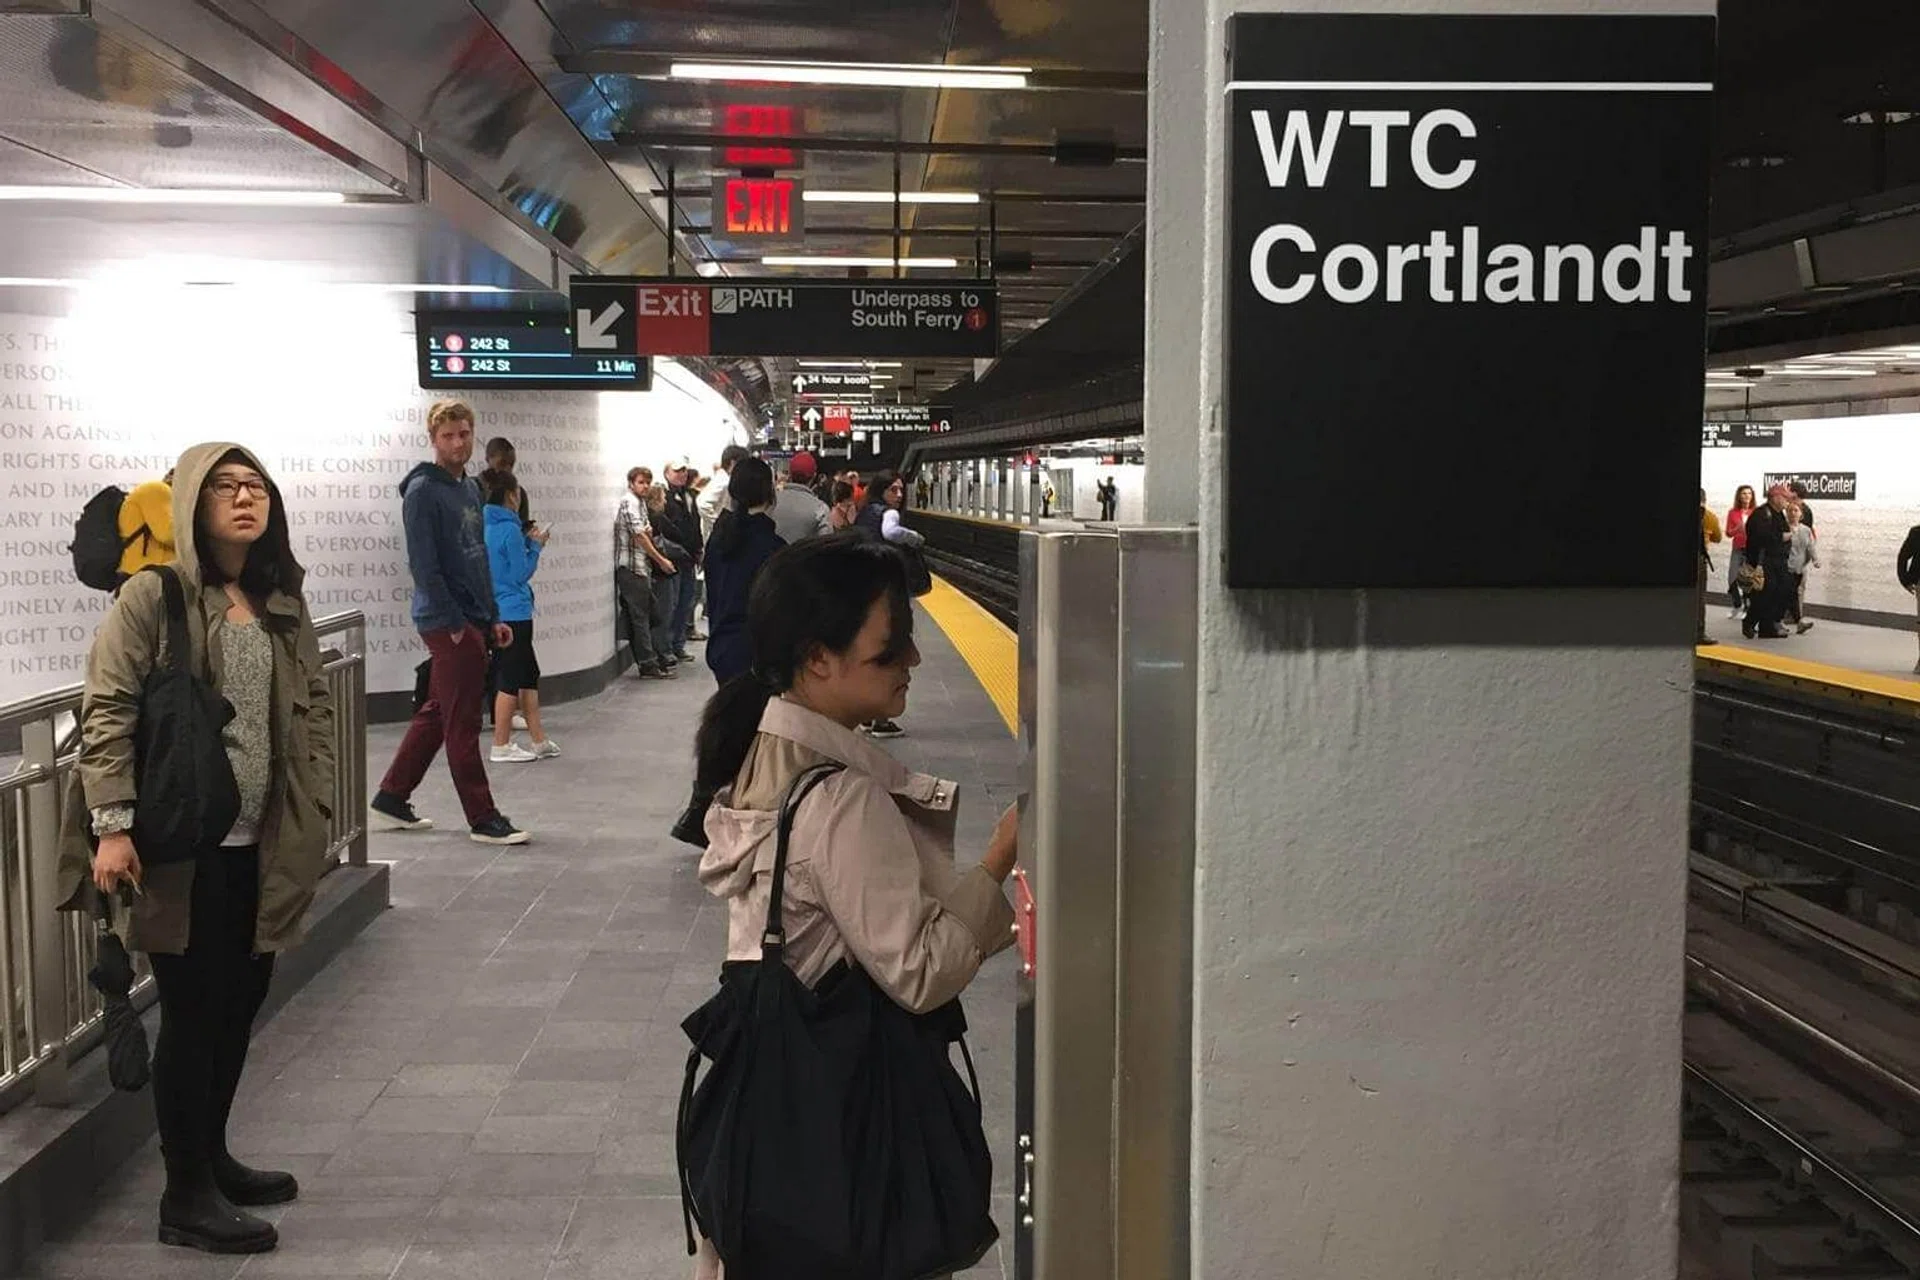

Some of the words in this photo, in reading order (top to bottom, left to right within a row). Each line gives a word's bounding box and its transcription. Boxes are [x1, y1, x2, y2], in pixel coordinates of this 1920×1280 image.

[1251, 109, 1477, 190] WTC
[726, 179, 793, 232] EXIT
[1250, 223, 1694, 303] Cortlandt
[639, 289, 702, 317] Exit
[739, 288, 793, 309] PATH
[852, 290, 952, 311] Underpass
[960, 291, 979, 308] to
[852, 310, 907, 328] South
[915, 311, 963, 330] Ferry
[429, 338, 441, 350] 1.
[470, 338, 494, 350] 242
[496, 338, 510, 350] St
[430, 360, 442, 371] 2.
[472, 360, 495, 371] 242
[497, 360, 510, 371] St
[597, 361, 612, 372] 11
[615, 361, 635, 372] Min
[822, 375, 841, 384] hour
[844, 374, 870, 384] booth
[824, 406, 848, 418] Exit
[88, 454, 179, 472] GRANTE
[280, 455, 316, 474] THE
[8, 482, 55, 499] AND
[296, 485, 316, 499] IN
[325, 485, 361, 499] THE
[1820, 474, 1854, 493] Center
[315, 510, 396, 528] PRIVACY,
[305, 535, 402, 552] EVERYONE
[363, 561, 399, 577] HAS
[304, 588, 385, 605] OLITICAL
[56, 625, 85, 642] TO
